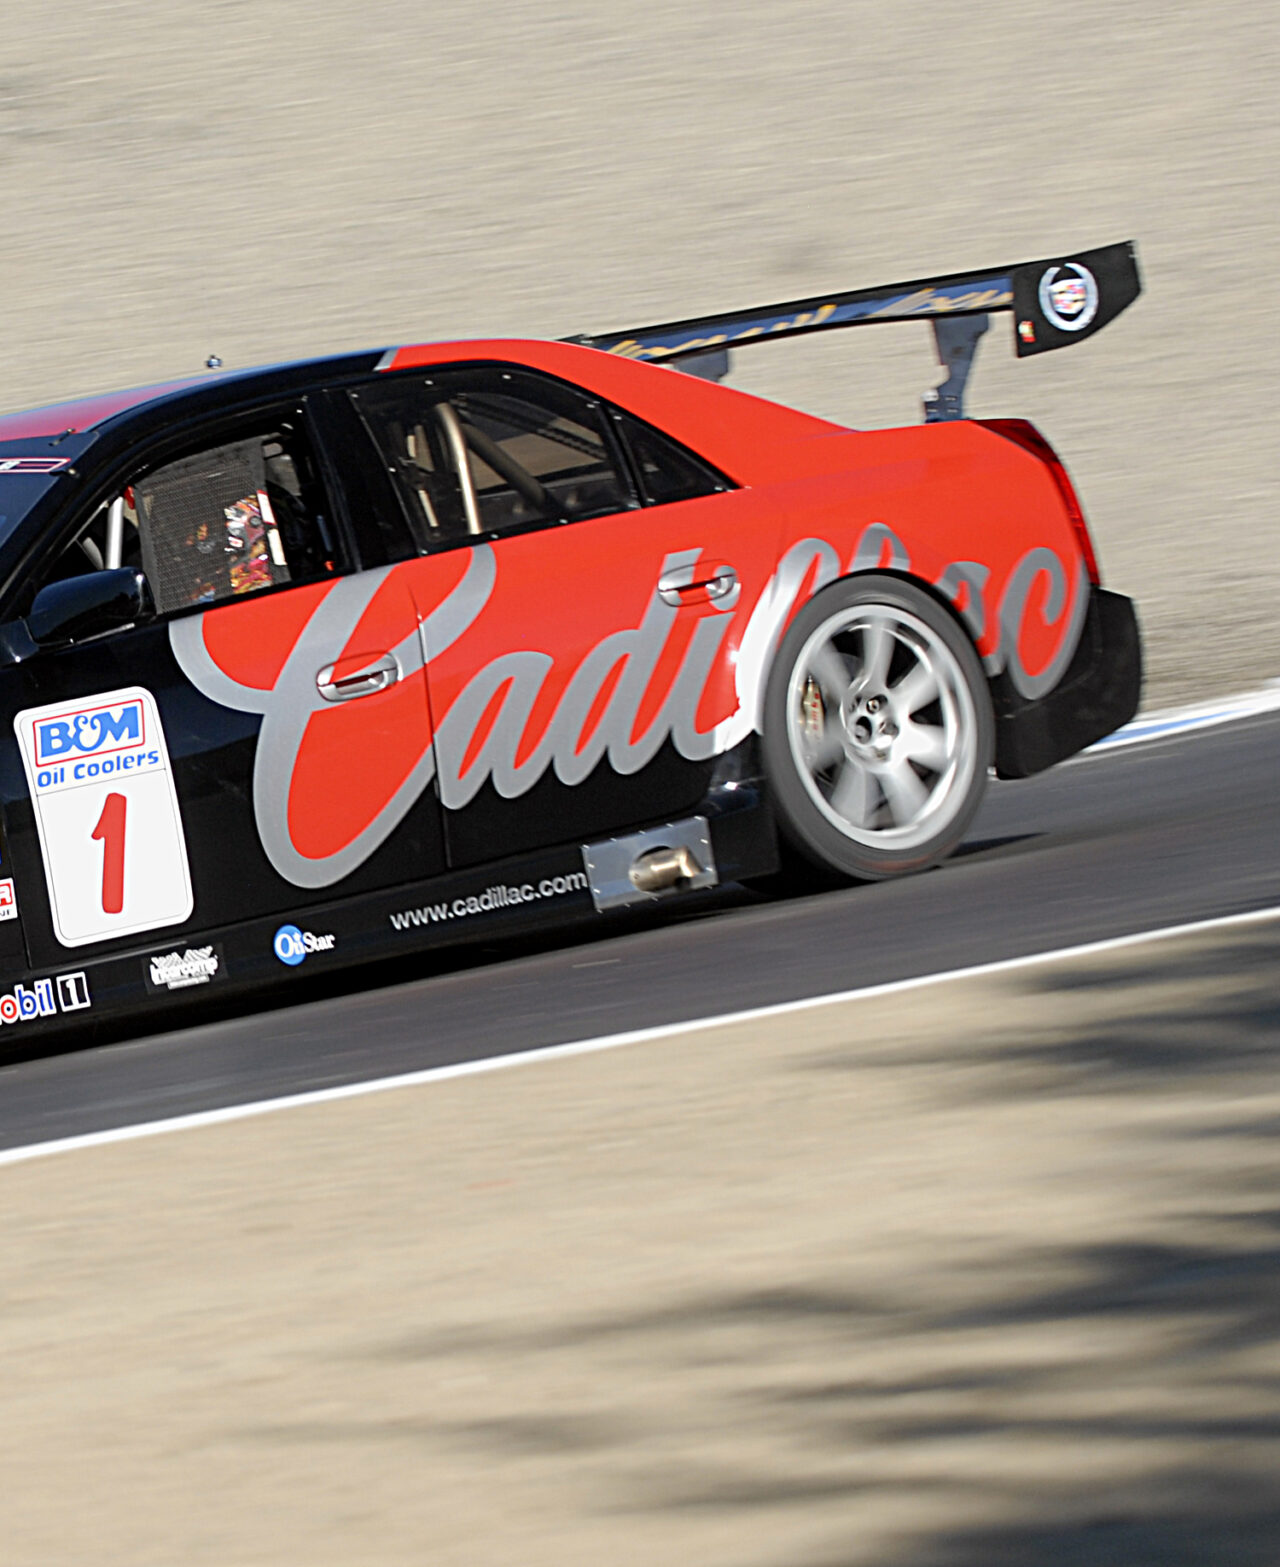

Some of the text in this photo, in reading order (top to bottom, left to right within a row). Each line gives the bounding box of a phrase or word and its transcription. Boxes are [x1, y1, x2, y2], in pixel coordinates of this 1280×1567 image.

[39, 705, 140, 758] B&M
[37, 750, 159, 788] Oil Coolers
[91, 792, 127, 914] 1
[390, 872, 589, 931] www.cadillac.com
